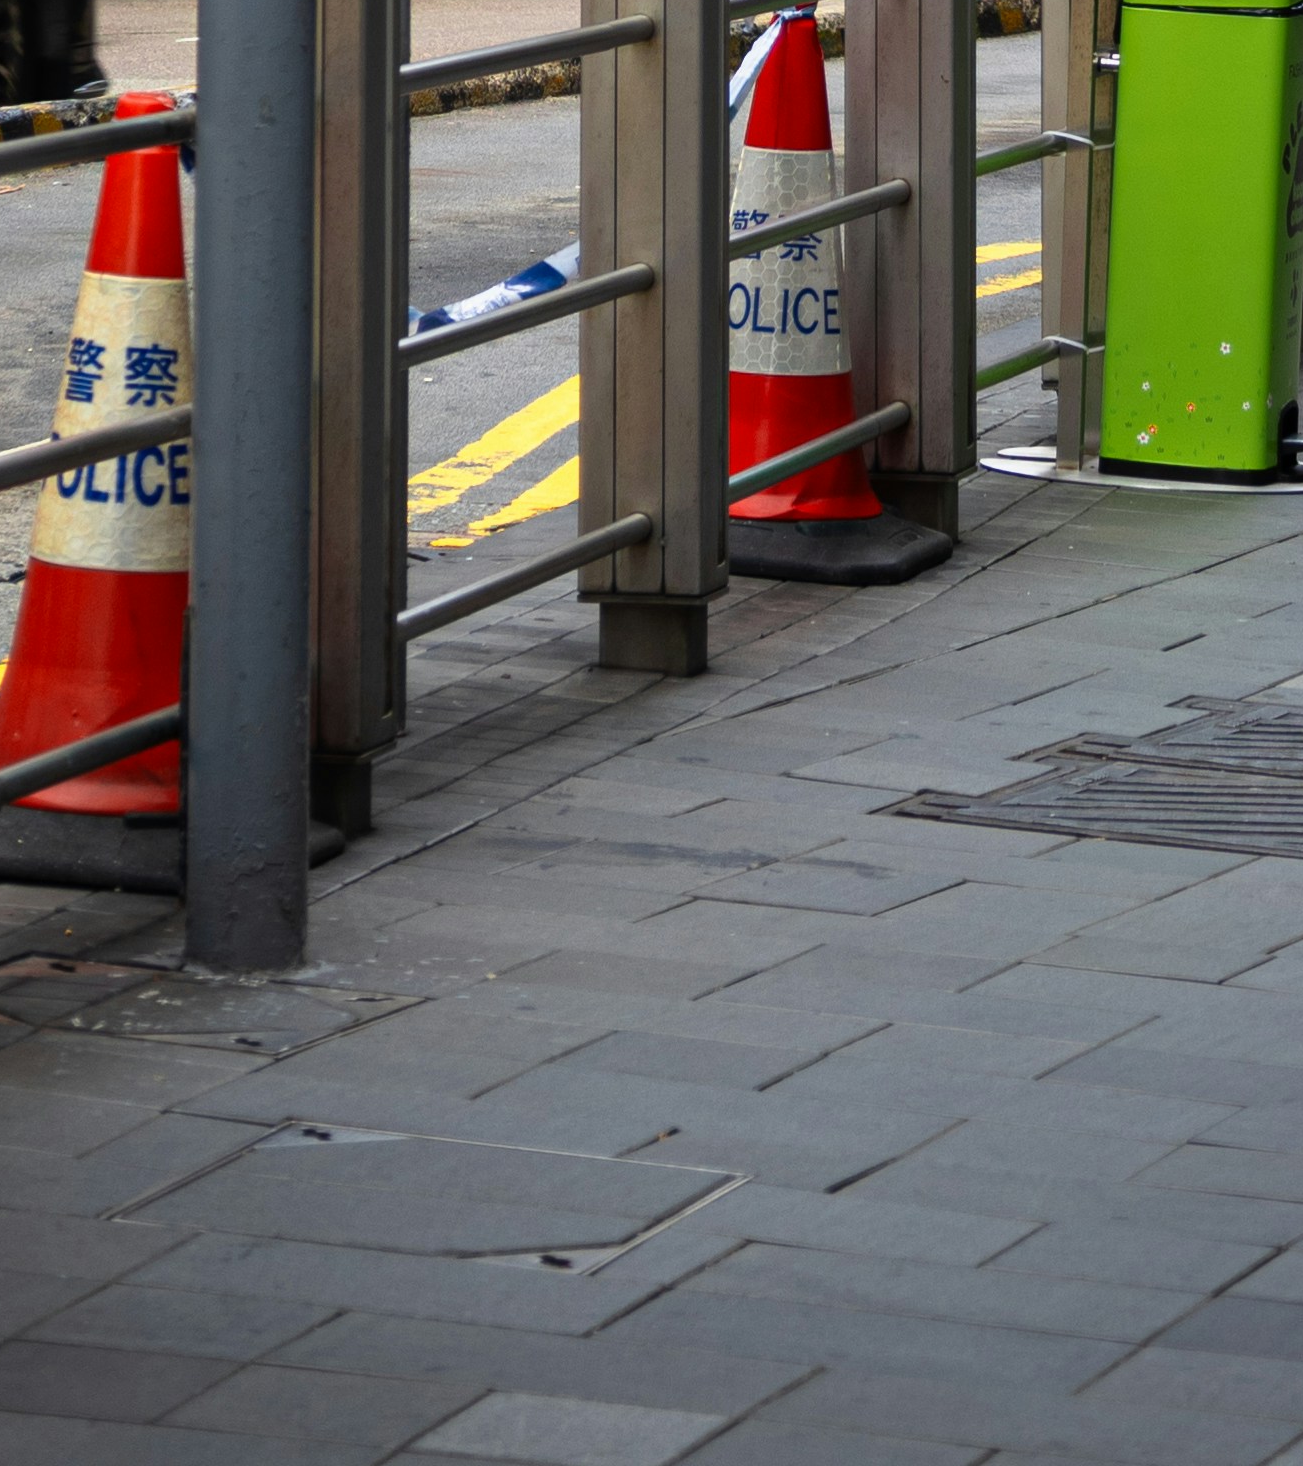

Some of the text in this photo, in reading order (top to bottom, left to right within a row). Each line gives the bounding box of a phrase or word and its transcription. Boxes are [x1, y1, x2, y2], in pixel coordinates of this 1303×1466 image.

[728, 283, 841, 335] OLICE
[64, 336, 179, 407] 警察
[45, 435, 191, 507] OLICE
